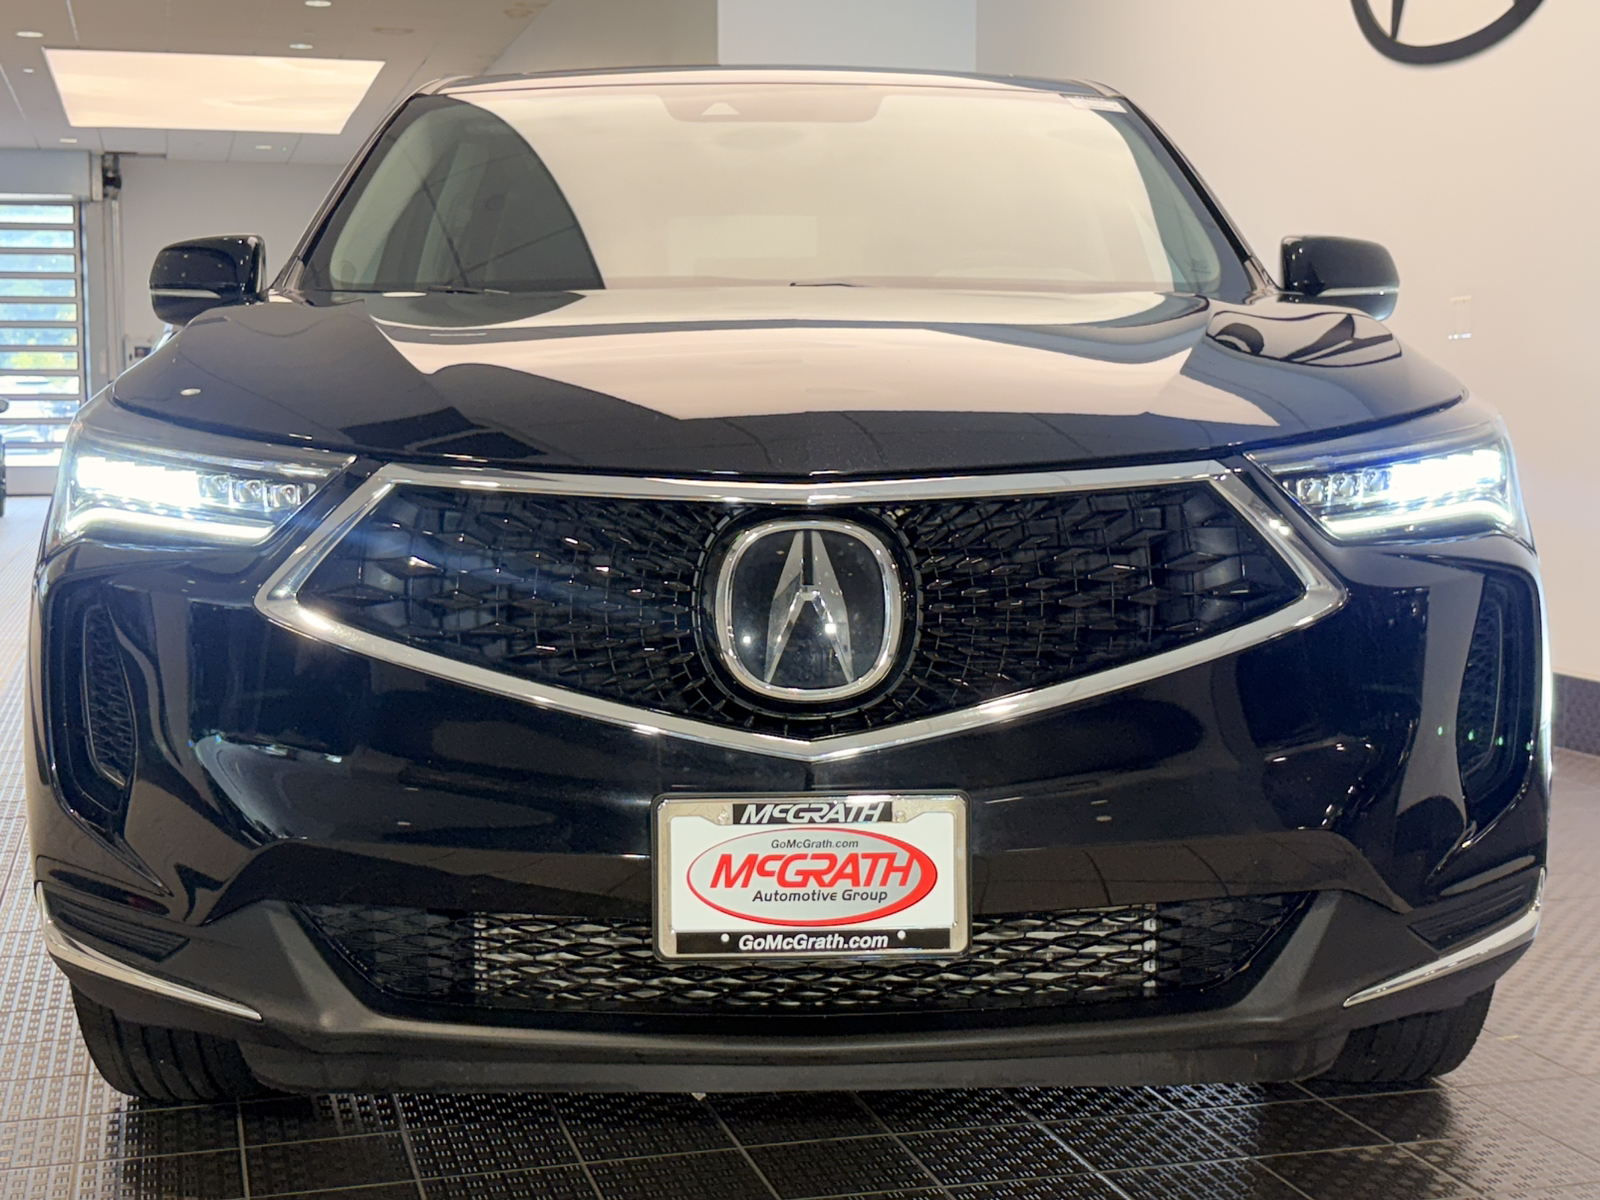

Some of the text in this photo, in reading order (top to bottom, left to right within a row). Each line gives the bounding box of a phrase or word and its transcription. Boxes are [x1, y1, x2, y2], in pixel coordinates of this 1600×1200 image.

[740, 803, 884, 824] McGRATH
[771, 838, 859, 849] GoMcGrath.com
[710, 852, 914, 888] McGRATH
[752, 889, 888, 903] Automotive Group
[738, 934, 889, 951] GoMcGrath.com
